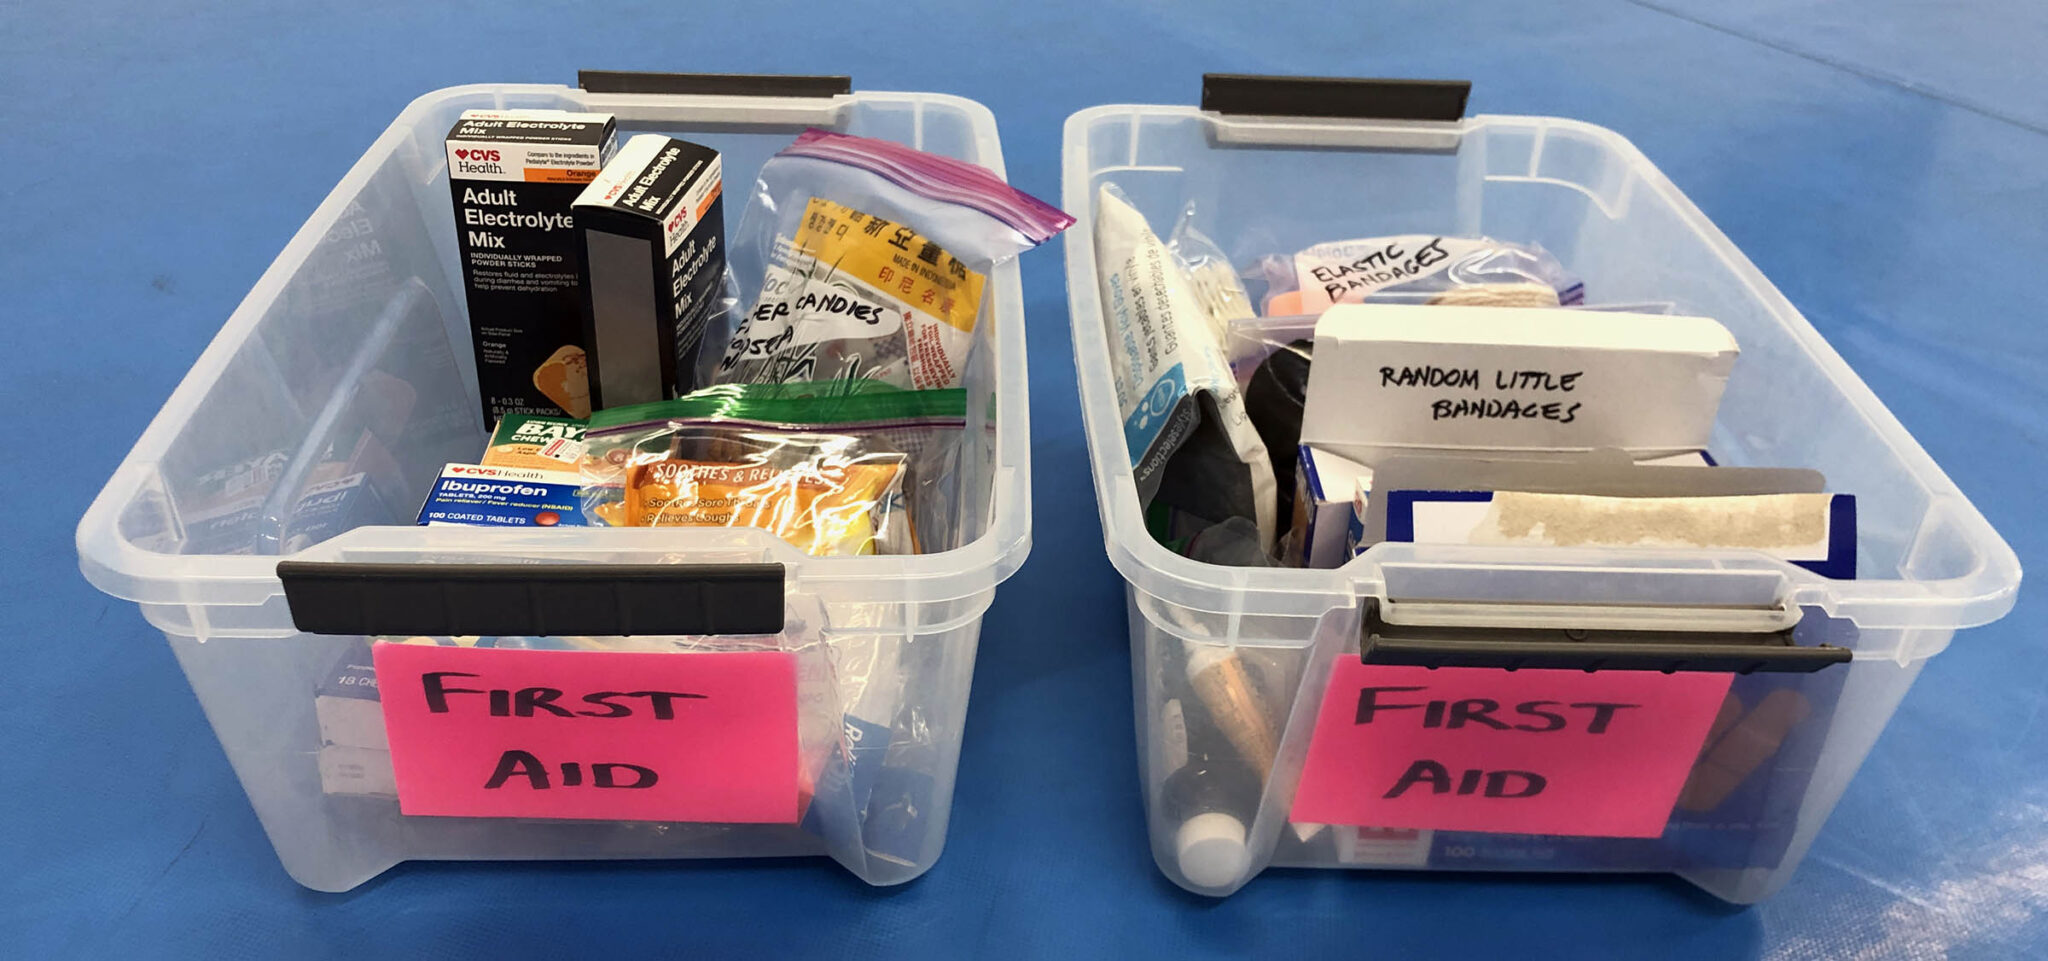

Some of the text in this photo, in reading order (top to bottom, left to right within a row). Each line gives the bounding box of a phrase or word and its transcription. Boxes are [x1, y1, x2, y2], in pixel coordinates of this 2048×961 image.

[459, 127, 487, 135] Mix
[463, 120, 586, 131] Adult Electrolyte
[470, 149, 501, 162] CVS
[527, 151, 548, 159] Compare
[563, 152, 589, 160] ingredients
[550, 158, 575, 167] Electrolyte
[459, 161, 502, 175] Health
[566, 169, 597, 178] Orange
[622, 185, 650, 207] Adult
[638, 147, 681, 187] Electrolyte
[463, 187, 518, 206] Adult
[639, 195, 662, 212] Mix
[464, 208, 574, 232] Electrolyte
[673, 206, 688, 228] CVS
[468, 231, 506, 249] Mix
[669, 220, 690, 247] Health
[470, 252, 563, 262] INDIVIDUALLY WRAPPED
[471, 259, 506, 267] POWDER
[671, 239, 696, 279] Adult
[892, 252, 911, 270] MADE
[910, 261, 920, 274] IN
[1311, 242, 1405, 283] ELASTIC
[473, 269, 503, 278] Restores
[504, 271, 519, 279] fluid
[534, 272, 575, 281] electrolytes
[673, 235, 717, 298] Electrolyte
[1324, 237, 1451, 303] BANDAGES
[473, 276, 495, 285] during
[496, 278, 525, 286] diarrhea
[540, 279, 570, 288] vomiting
[474, 283, 558, 294] help prevent dehydration
[674, 292, 693, 320] Mix
[796, 293, 884, 326] CANDIES
[1159, 312, 1178, 356] Guantes
[482, 341, 507, 349] Orange
[933, 322, 956, 379] INDIVIDUALLY
[917, 338, 934, 387] FRESHNESS
[1379, 365, 1584, 392] RANDOM LITTLE
[502, 397, 514, 406] 0.3
[514, 407, 536, 415] STICK
[1432, 398, 1583, 423] BANDAGES
[515, 423, 588, 440] BAY
[466, 467, 544, 480] CVS Health
[733, 469, 745, 483] &
[441, 480, 548, 497] Ibuprofen
[510, 501, 540, 509] reducer
[541, 503, 574, 512] (NSAID)
[698, 498, 724, 509] Sore
[447, 512, 484, 521] COATED
[486, 515, 526, 524] TABLETS
[338, 675, 356, 686] 18
[420, 671, 710, 722] FIRST
[1352, 684, 1644, 737] FIRST
[484, 749, 661, 791] AID
[1380, 758, 1548, 800] AID
